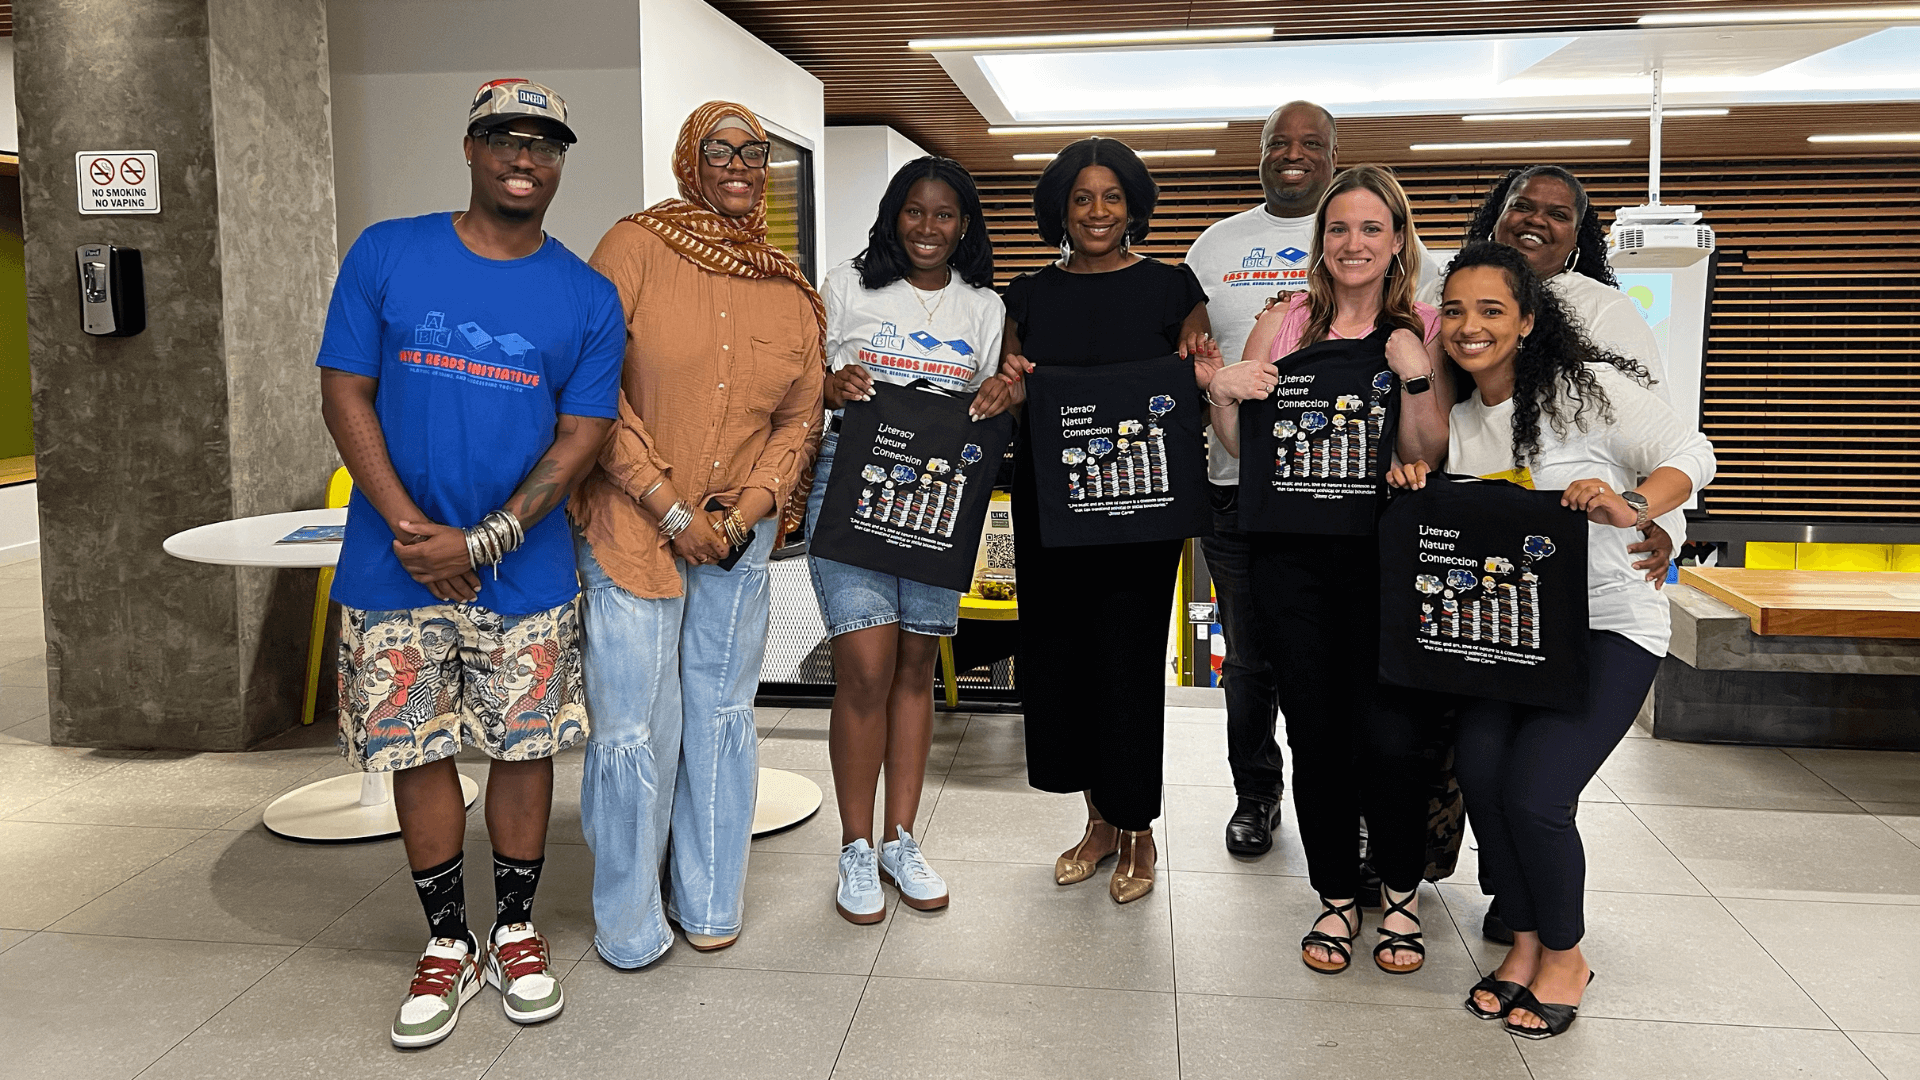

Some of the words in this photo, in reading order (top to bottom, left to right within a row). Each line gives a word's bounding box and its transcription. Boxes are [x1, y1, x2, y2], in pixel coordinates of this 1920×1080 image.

[520, 91, 545, 105] DUNGEON
[92, 189, 104, 197] NO
[106, 189, 146, 197] SMOKING
[96, 199, 108, 207] NO
[111, 199, 144, 207] VAPING
[1223, 272, 1249, 282] EAST
[1253, 271, 1278, 279] NEW
[1283, 270, 1307, 278] YOR
[427, 317, 438, 328] A
[884, 326, 892, 334] A
[420, 332, 428, 342] B
[436, 333, 446, 344] C
[891, 339, 900, 347] C
[425, 353, 465, 371] READS
[467, 362, 540, 387] INITIATIVE
[858, 350, 877, 363] NYC
[881, 355, 920, 370] READS
[923, 362, 975, 380] INITIATIV
[1279, 375, 1315, 384] Literacy
[1277, 387, 1309, 396] Nature
[1278, 399, 1329, 409] Connection
[1061, 405, 1096, 415] Literacy
[1062, 417, 1092, 427] Nature
[878, 423, 915, 440] Literacy
[1063, 427, 1112, 438] Connection
[875, 435, 907, 449] Nature
[872, 446, 922, 466] Connection
[1419, 525, 1460, 539] Literacy
[1420, 538, 1455, 551] Nature
[1419, 552, 1478, 567] Connection
